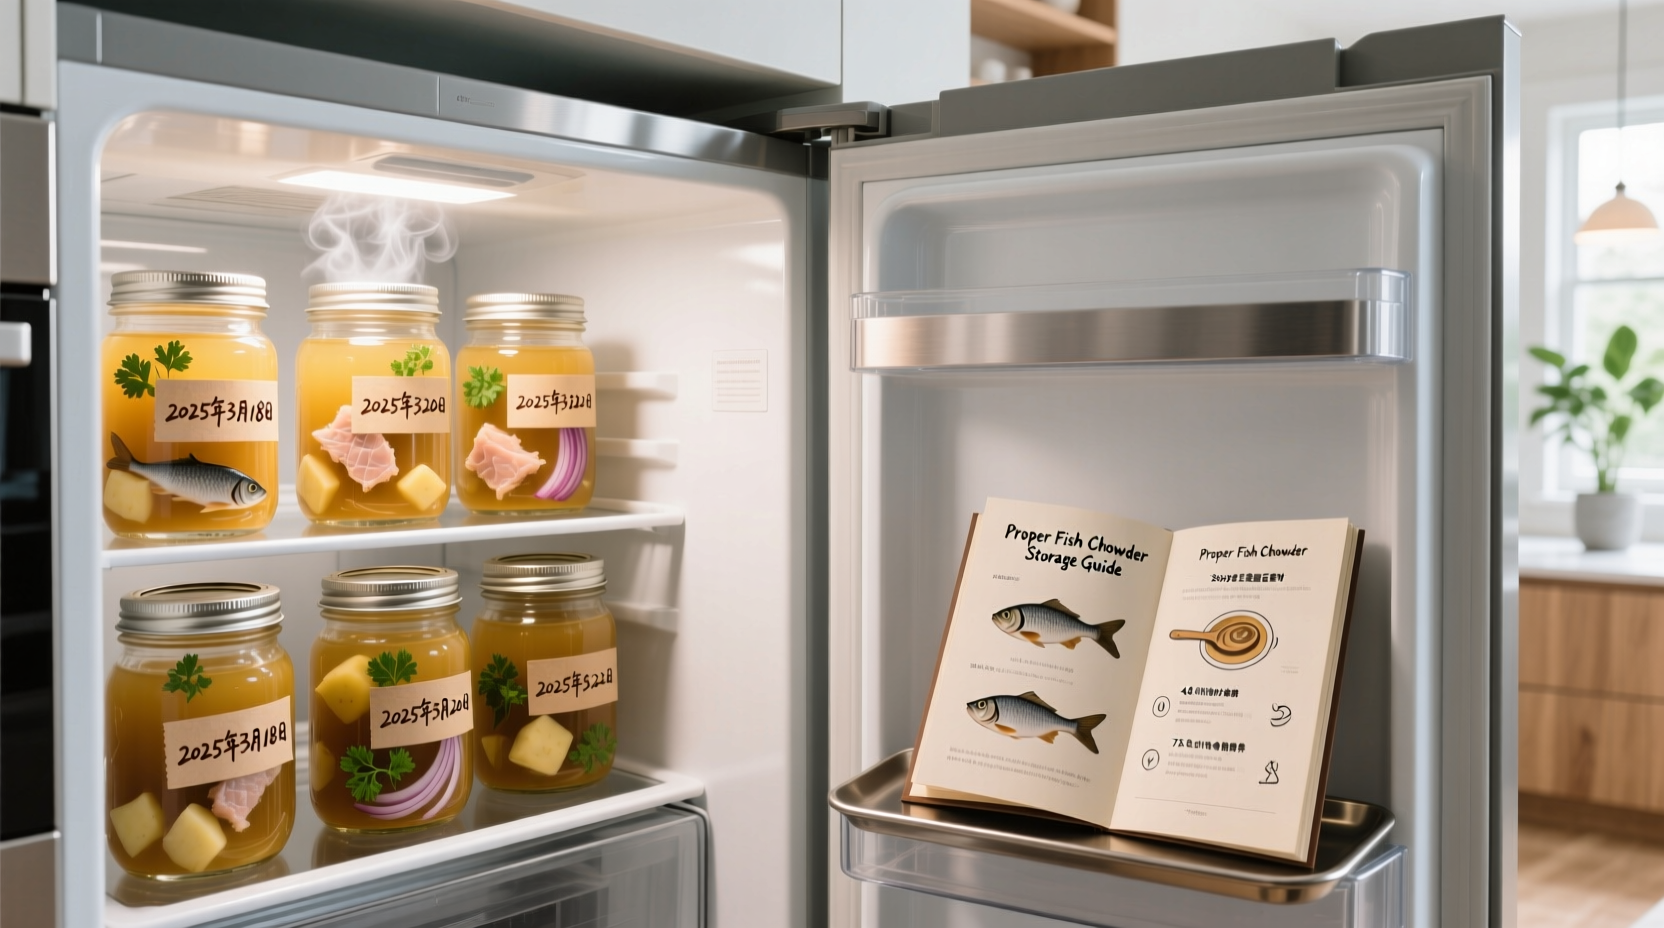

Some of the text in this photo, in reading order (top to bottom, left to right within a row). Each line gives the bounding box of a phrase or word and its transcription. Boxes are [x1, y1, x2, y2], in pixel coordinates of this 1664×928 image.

[165, 396, 273, 428] 2025年3月18日
[360, 391, 446, 420] 2025年320日
[1005, 523, 1149, 562] Proper Fish Chowder
[1199, 544, 1308, 564] Proper Fish Chowder
[1025, 545, 1122, 577] Storage Guide
[177, 721, 287, 767] 2025年3月18日
